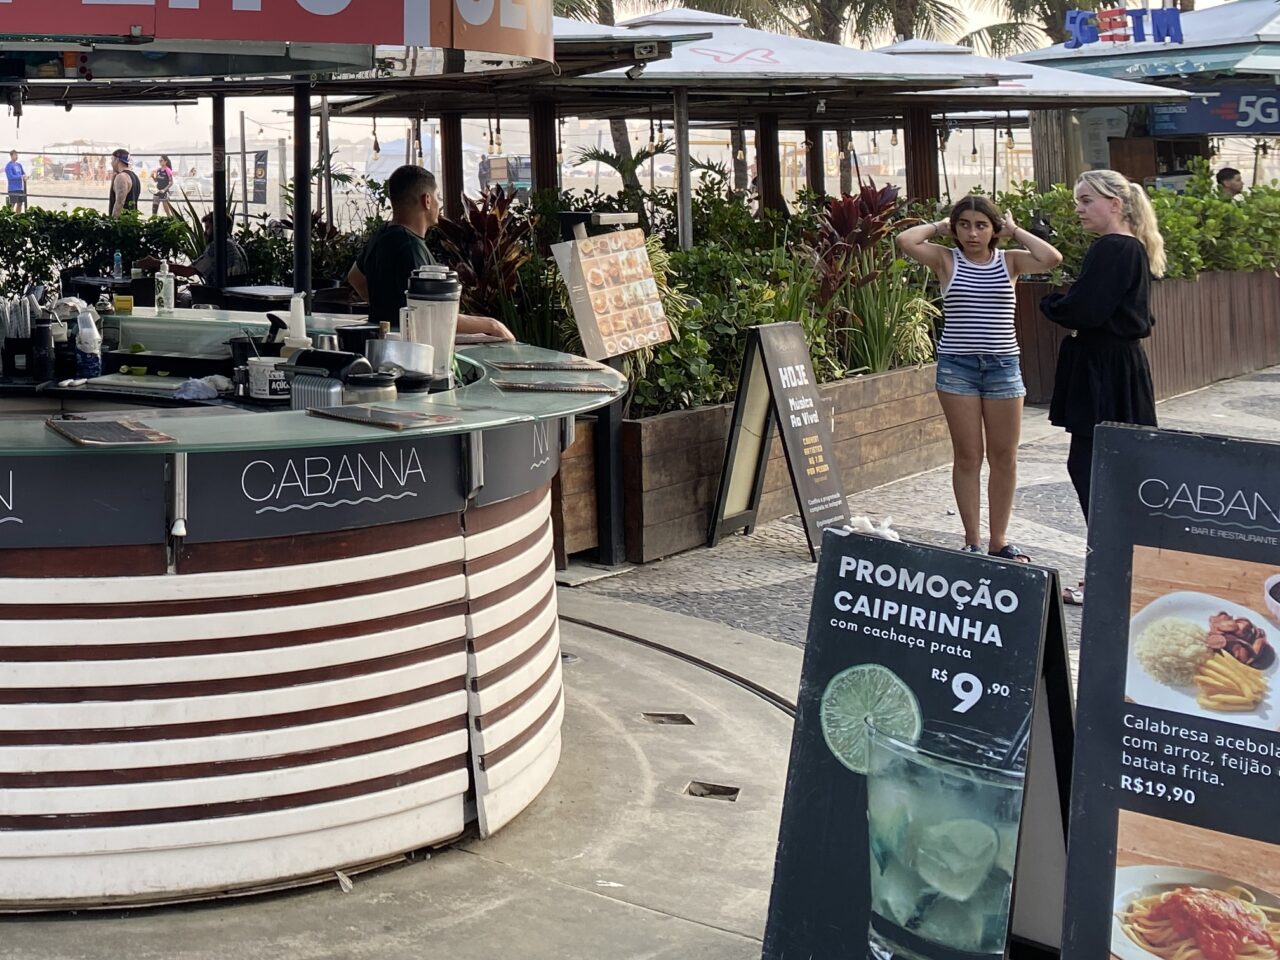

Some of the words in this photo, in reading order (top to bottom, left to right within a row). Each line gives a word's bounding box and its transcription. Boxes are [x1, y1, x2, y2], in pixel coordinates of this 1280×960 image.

[1236, 95, 1279, 128] 5G
[778, 364, 809, 389] HOJE
[241, 447, 426, 502] CABANNA
[839, 555, 1019, 614] PROMOÇÃO
[833, 590, 1003, 648] CAIPIRINHA
[830, 618, 858, 632] com
[863, 626, 926, 649] cachaça
[930, 641, 972, 659] prata
[931, 668, 948, 683] R$
[1123, 714, 1209, 743] Calabresa
[1122, 735, 1158, 752] com
[1163, 743, 1215, 766] arroz,
[1221, 753, 1271, 776] feijão
[1122, 751, 1176, 775] batata
[1182, 764, 1225, 786] frita.
[1121, 775, 1196, 805] R$19,90
